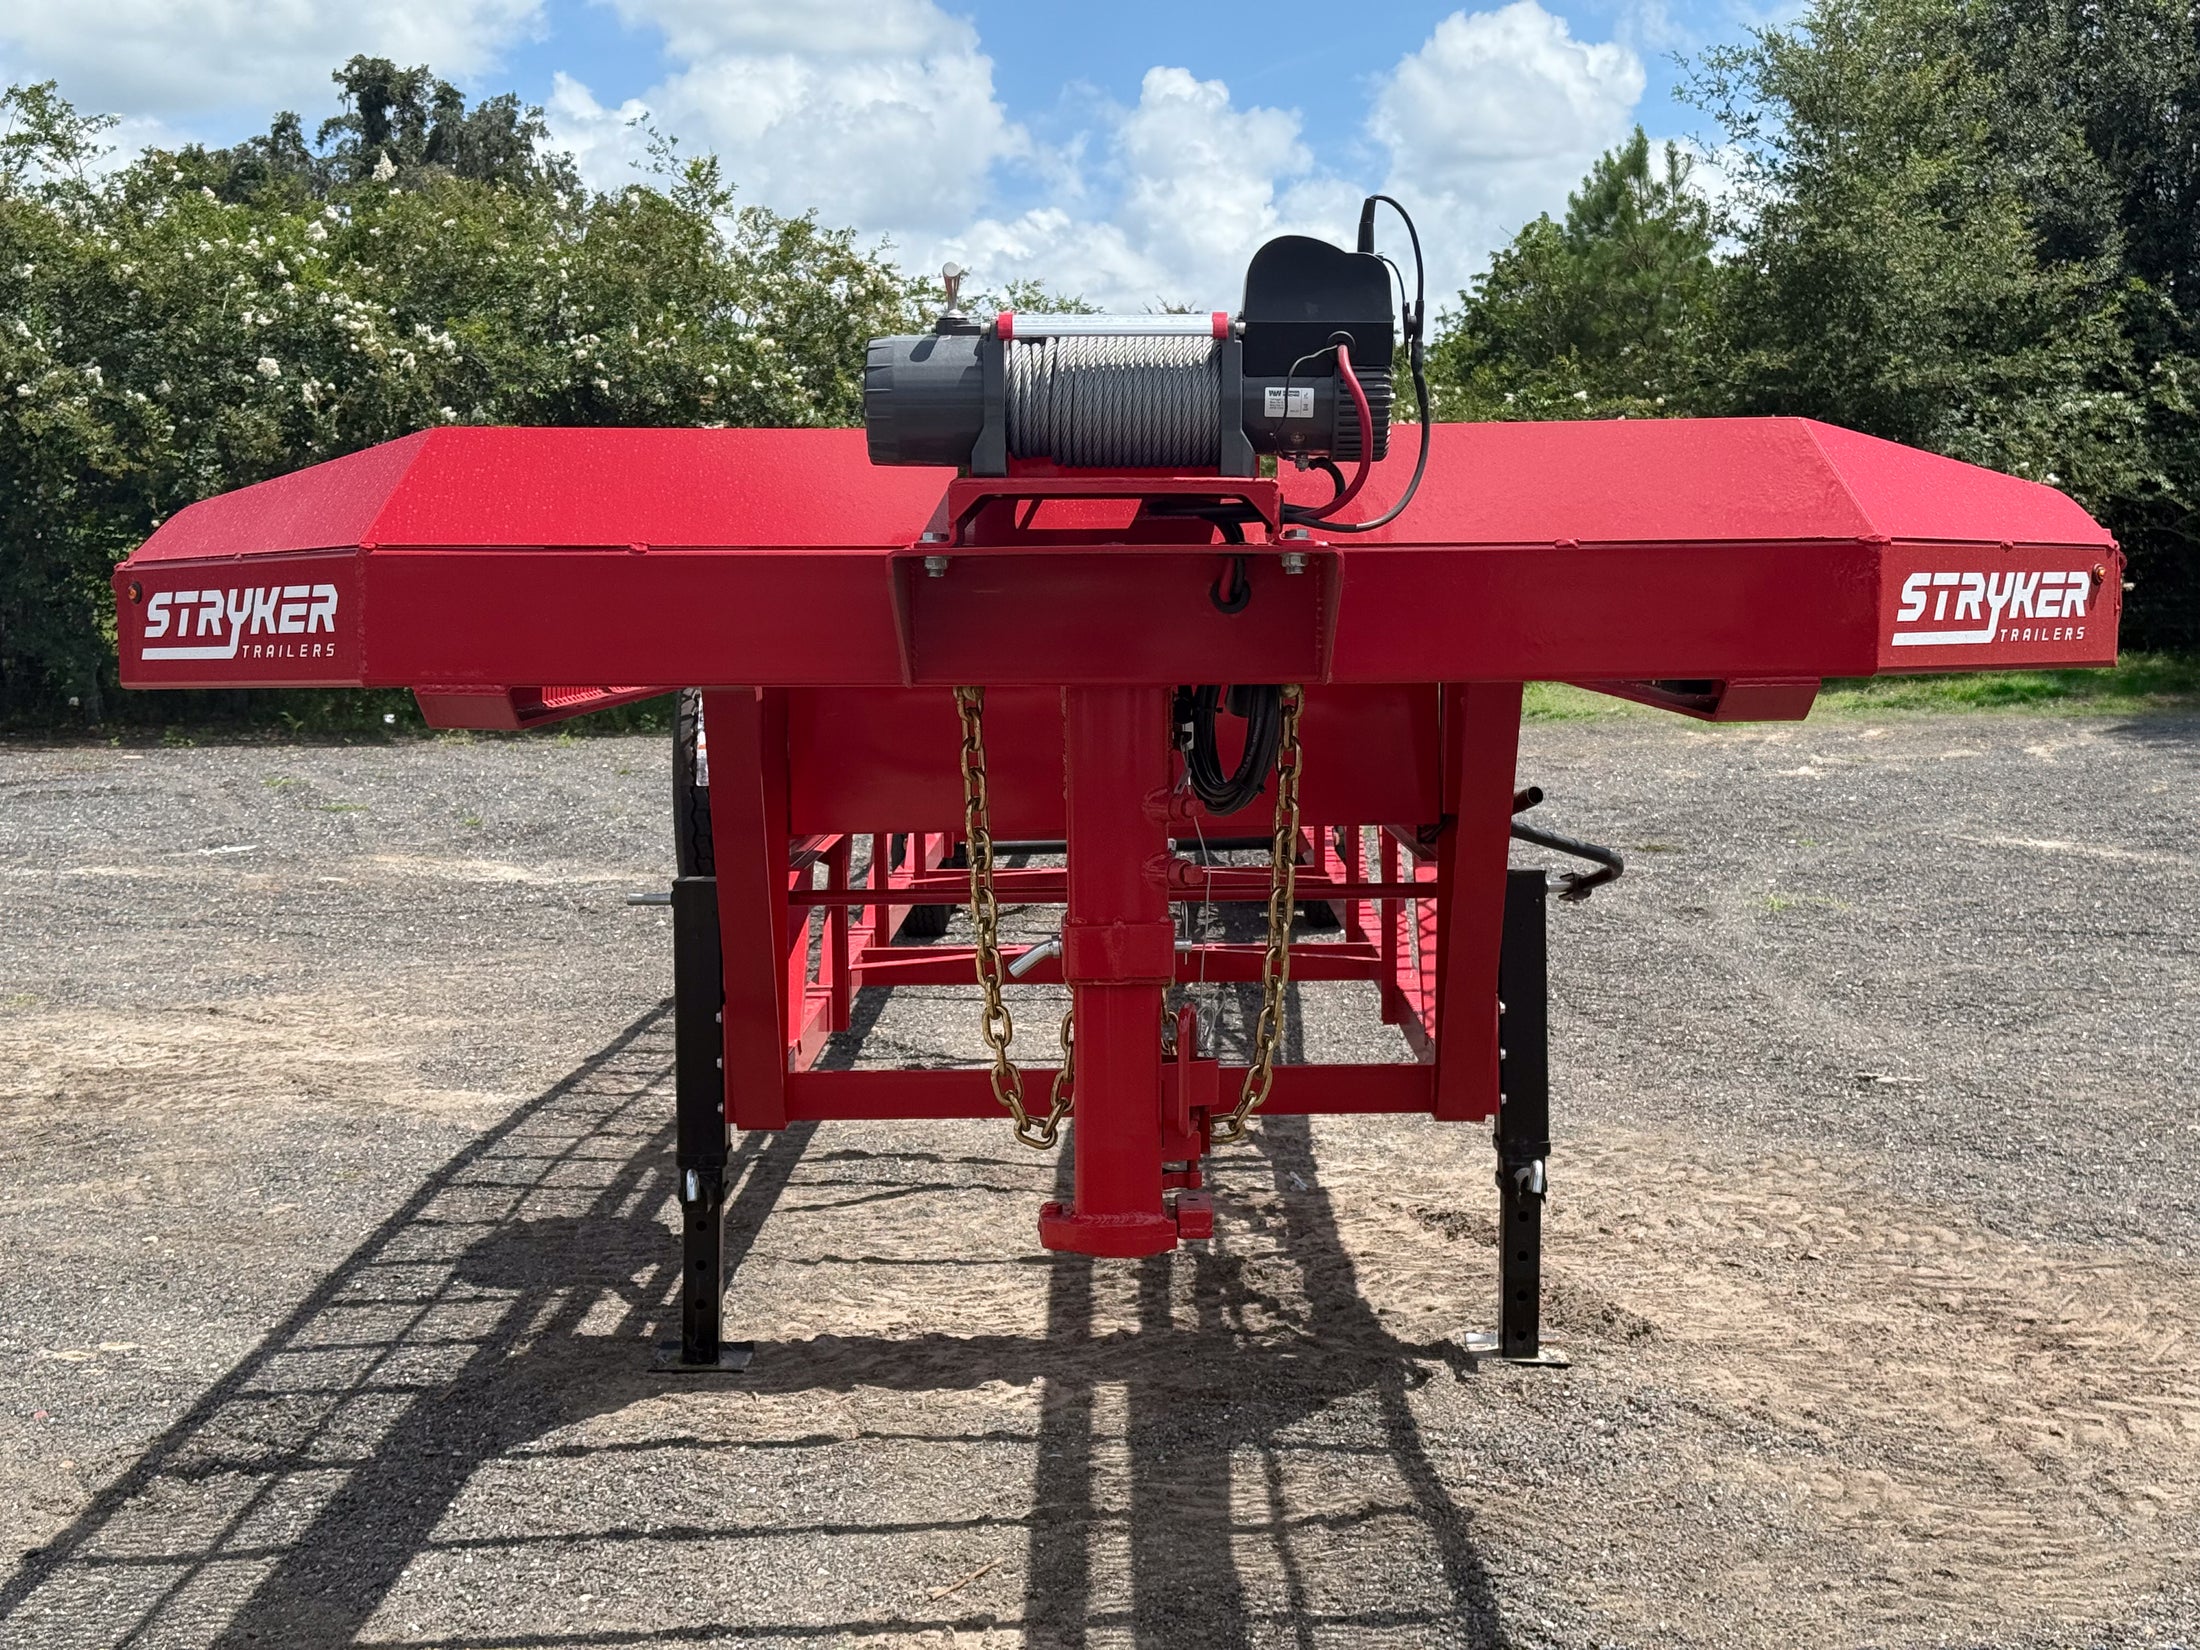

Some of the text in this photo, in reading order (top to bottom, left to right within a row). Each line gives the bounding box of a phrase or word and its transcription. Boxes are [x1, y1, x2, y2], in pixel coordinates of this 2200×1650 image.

[142, 584, 338, 660] STRYKER
[1891, 571, 2090, 646] STRYKER
[242, 643, 335, 658] TRAILERS
[2000, 626, 2085, 642] TRAILERS
